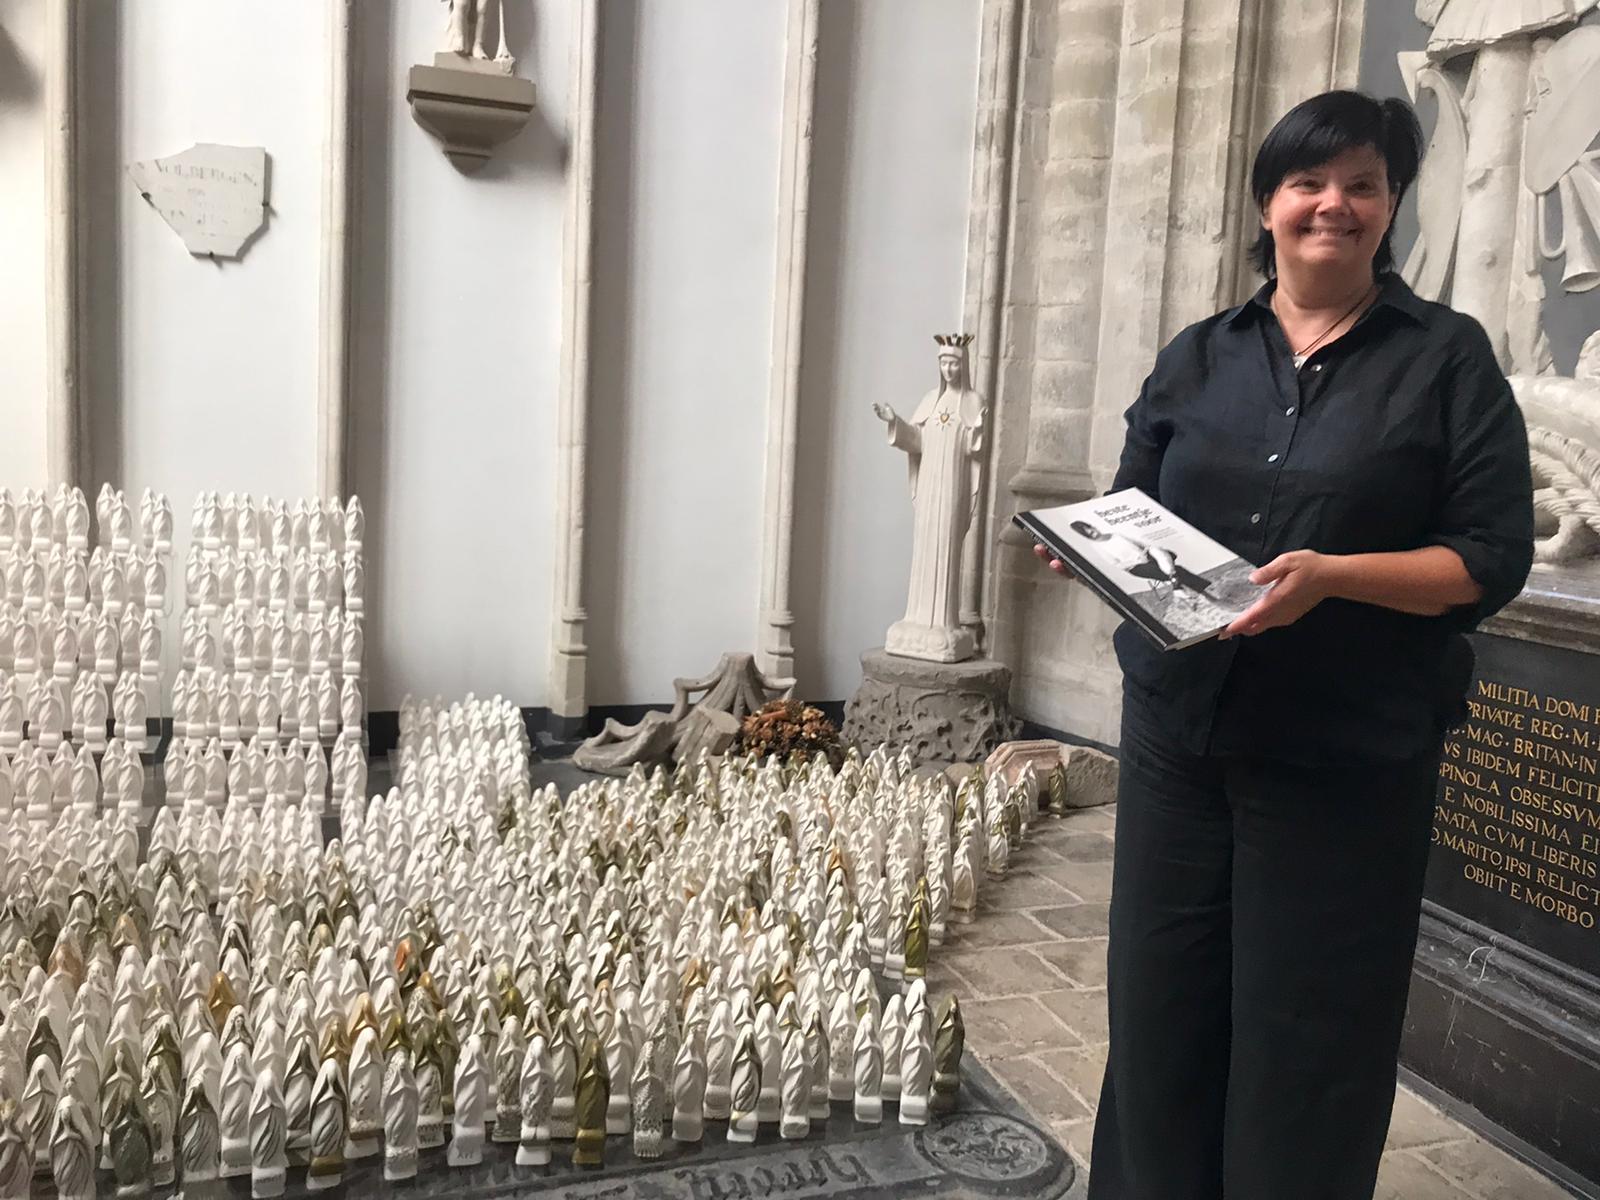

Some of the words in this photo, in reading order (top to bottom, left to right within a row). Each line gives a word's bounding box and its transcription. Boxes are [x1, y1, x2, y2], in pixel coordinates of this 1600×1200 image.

[1478, 680, 1540, 710] MILITIA
[1545, 696, 1590, 722] DOMI
[1466, 747, 1521, 778] IBIDEM
[1462, 792, 1572, 845] NOBILISSIMA
[1484, 825, 1526, 852] CVM
[1531, 841, 1598, 878] LIBERIS
[1505, 855, 1531, 879] IPSI
[1463, 863, 1508, 892] OBIIT
[1510, 882, 1522, 900] E
[1525, 887, 1595, 928] MORBO
